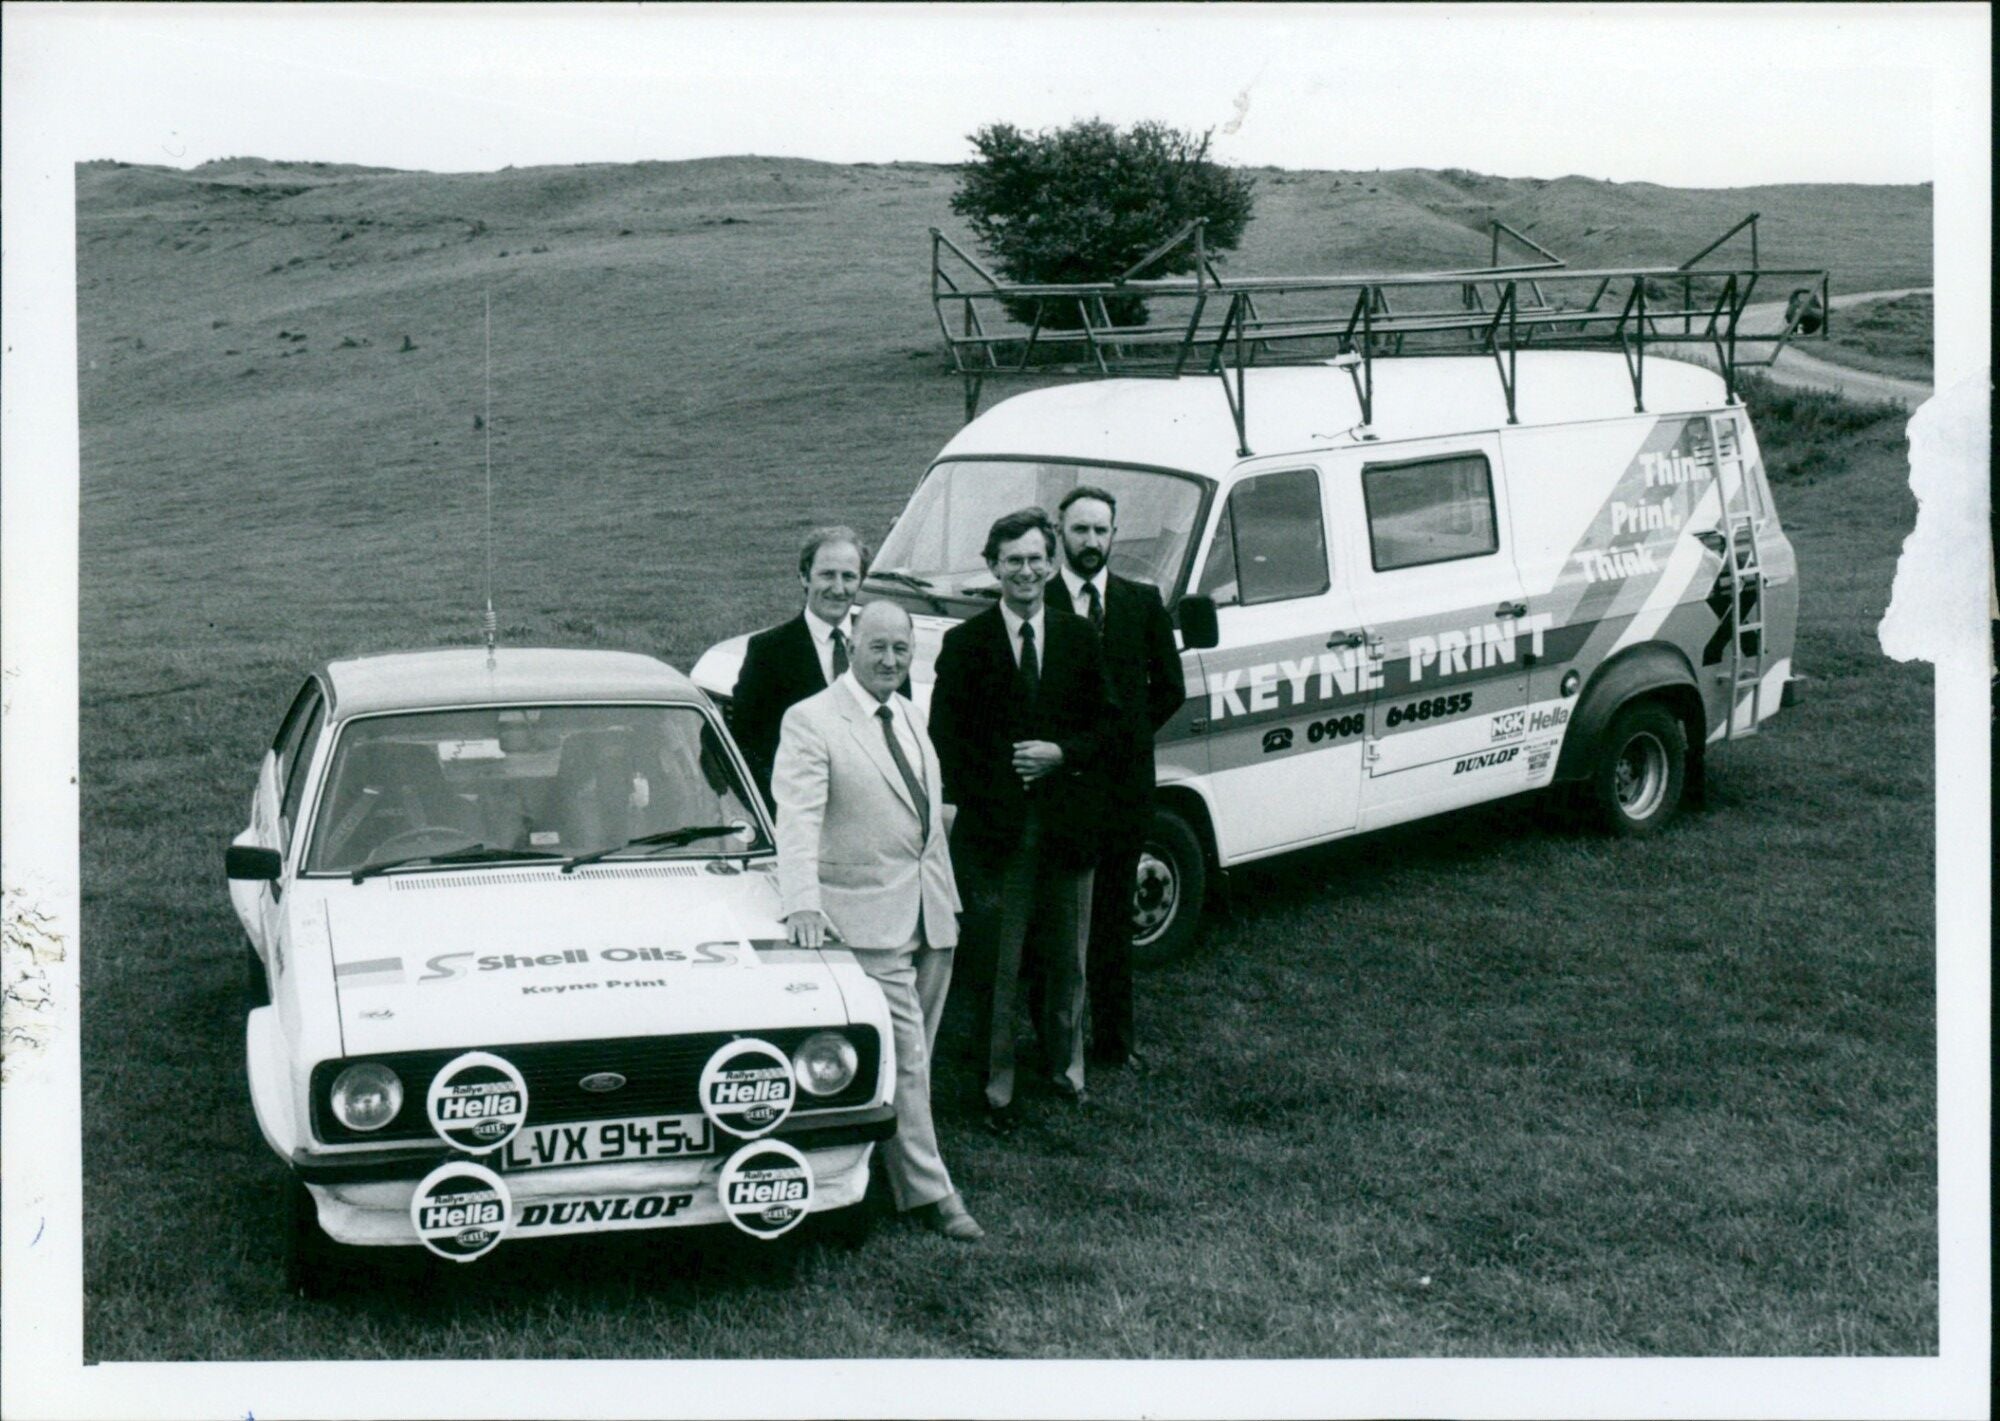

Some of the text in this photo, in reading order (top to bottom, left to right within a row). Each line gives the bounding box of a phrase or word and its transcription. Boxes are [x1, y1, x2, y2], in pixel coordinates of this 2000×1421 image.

[1208, 612, 1553, 720] KEYNE PRINT
[1307, 691, 1474, 744] 0908 648855
[1491, 710, 1526, 737] NGK
[1528, 706, 1569, 733] Hella
[1453, 746, 1520, 776] DUNLOP
[477, 948, 589, 972] Shell
[600, 946, 688, 963] Oils
[521, 978, 668, 995] Keyne Print
[725, 1071, 756, 1081] Rallye
[452, 1086, 483, 1096] Rallye
[715, 1080, 787, 1104] Hella
[442, 1094, 518, 1120] Hella
[507, 1118, 711, 1167] LVX 945J
[743, 1171, 774, 1181] Rallye
[434, 1195, 466, 1205] Rallye
[733, 1180, 804, 1204] Hella
[425, 1203, 500, 1229] Hella
[516, 1194, 694, 1228] DUNLOP
